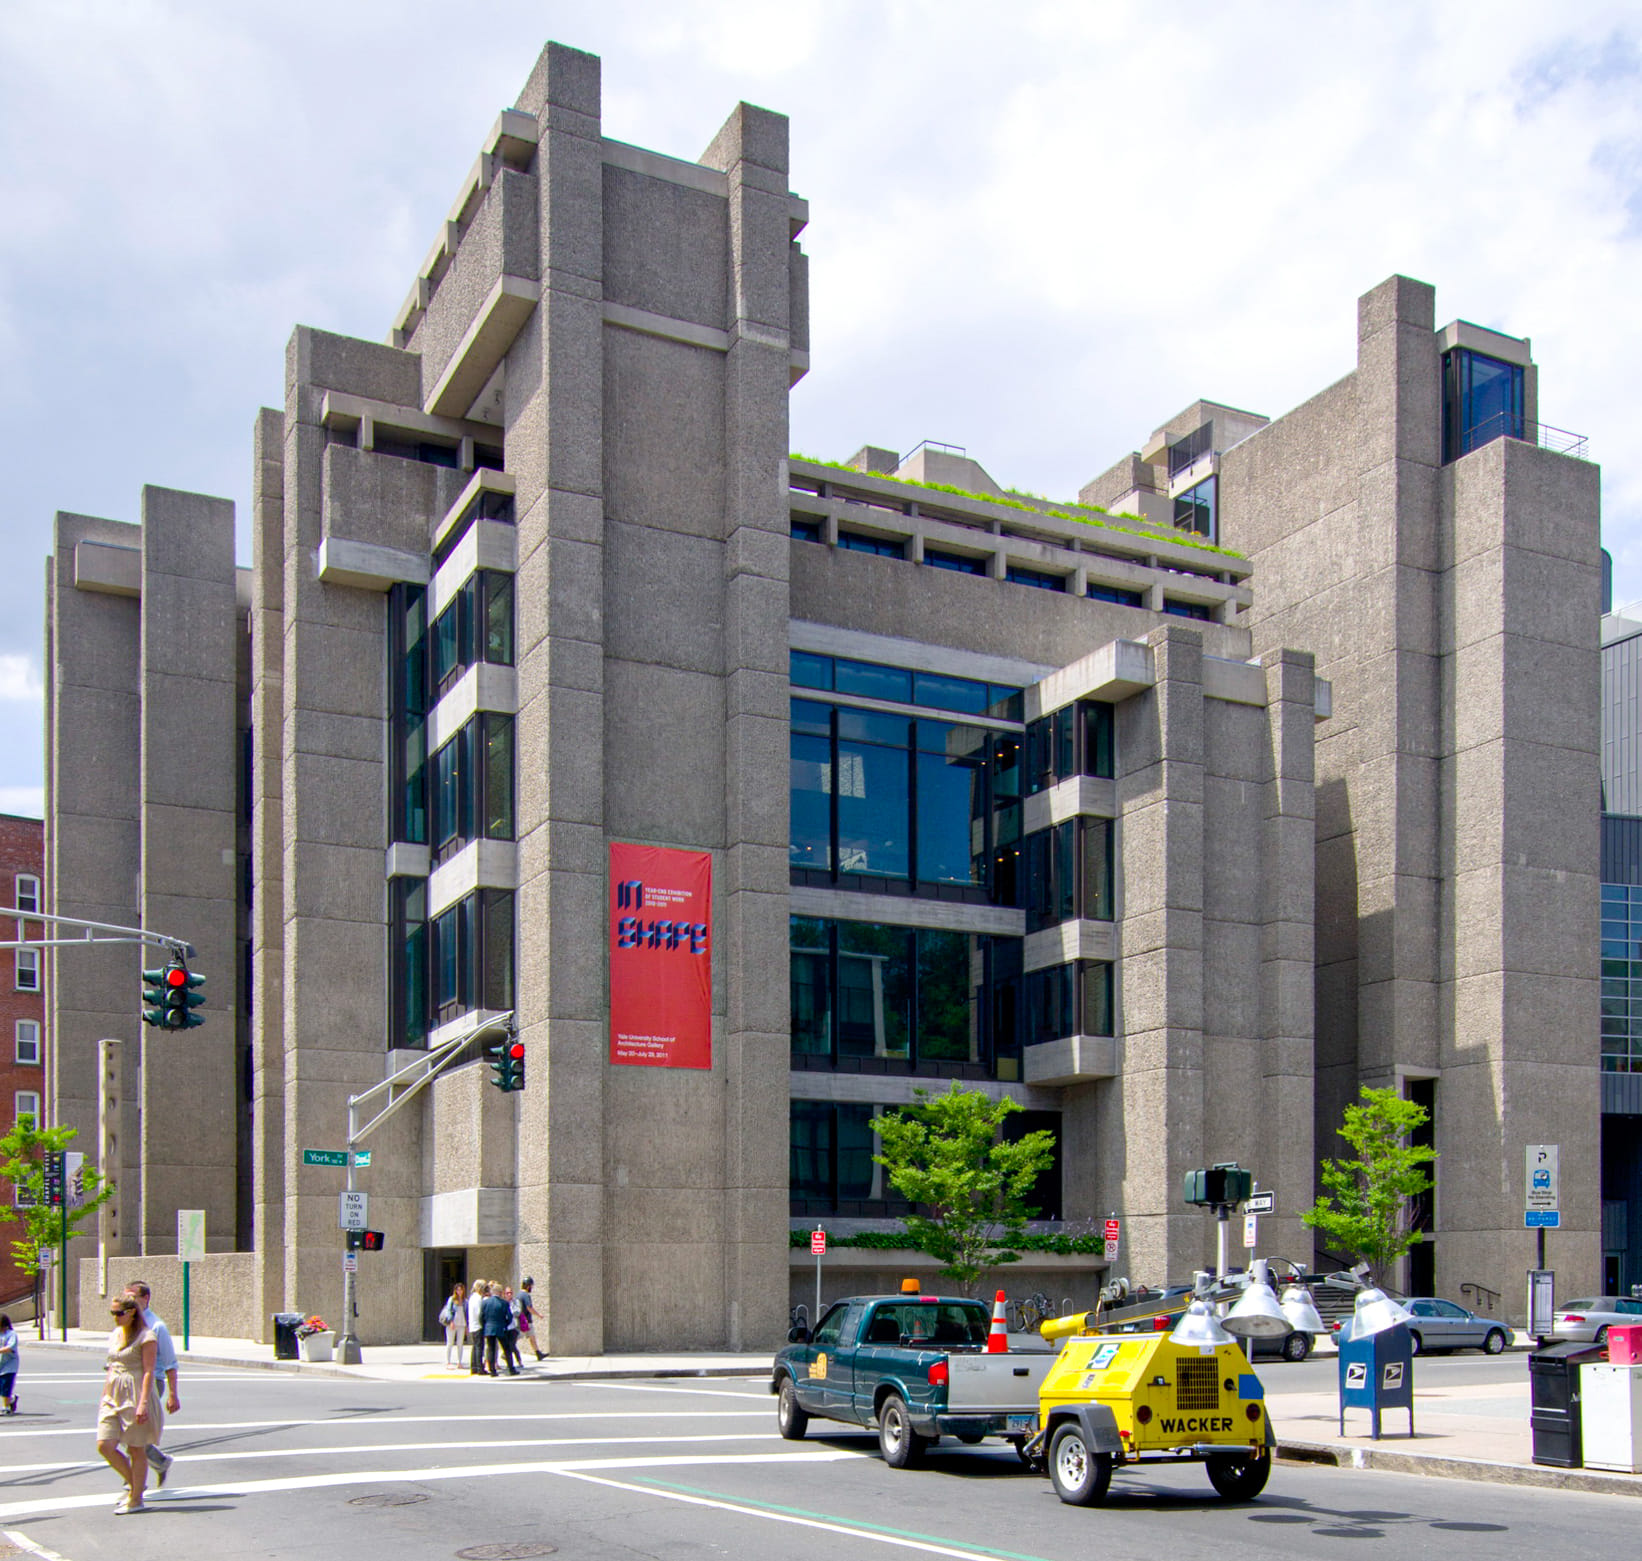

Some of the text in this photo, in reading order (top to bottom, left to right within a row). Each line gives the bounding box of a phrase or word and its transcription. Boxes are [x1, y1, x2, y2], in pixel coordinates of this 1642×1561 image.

[618, 880, 642, 911] IN
[618, 916, 707, 955] SHAPE
[309, 1152, 330, 1163] York
[347, 1194, 360, 1202] NO
[1160, 1417, 1233, 1433] WACKER
